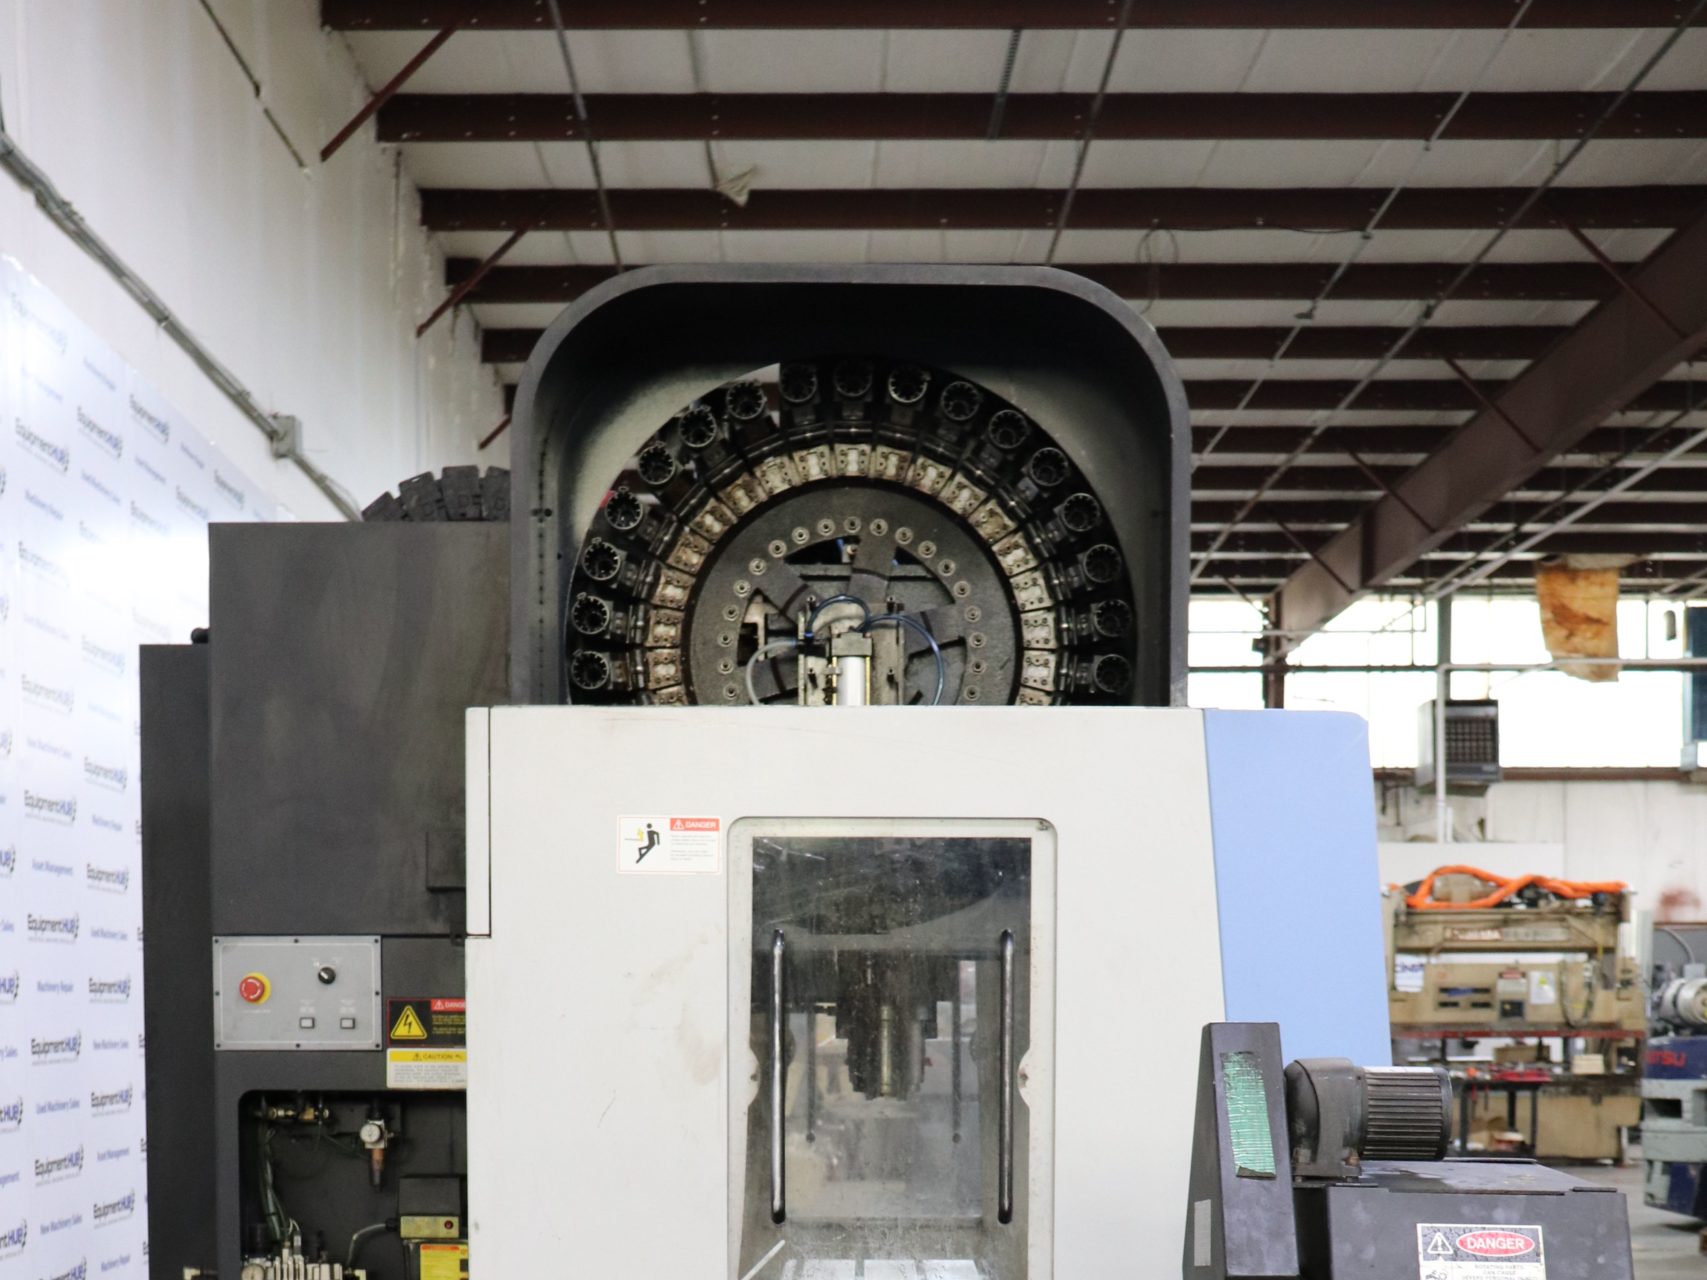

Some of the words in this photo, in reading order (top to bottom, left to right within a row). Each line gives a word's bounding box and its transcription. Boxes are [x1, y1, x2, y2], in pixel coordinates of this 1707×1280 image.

[685, 821, 717, 830] DANGER
[28, 913, 75, 935] EquipmentHUB
[89, 977, 128, 995] EquipmentHUB
[31, 1036, 77, 1057] EquipmentHUB
[91, 1088, 130, 1109] EquipmentHUB
[35, 1151, 80, 1177] EquipmentHUB
[93, 1195, 132, 1220] EquipmentHUB
[1466, 1237, 1525, 1250] DANGER
